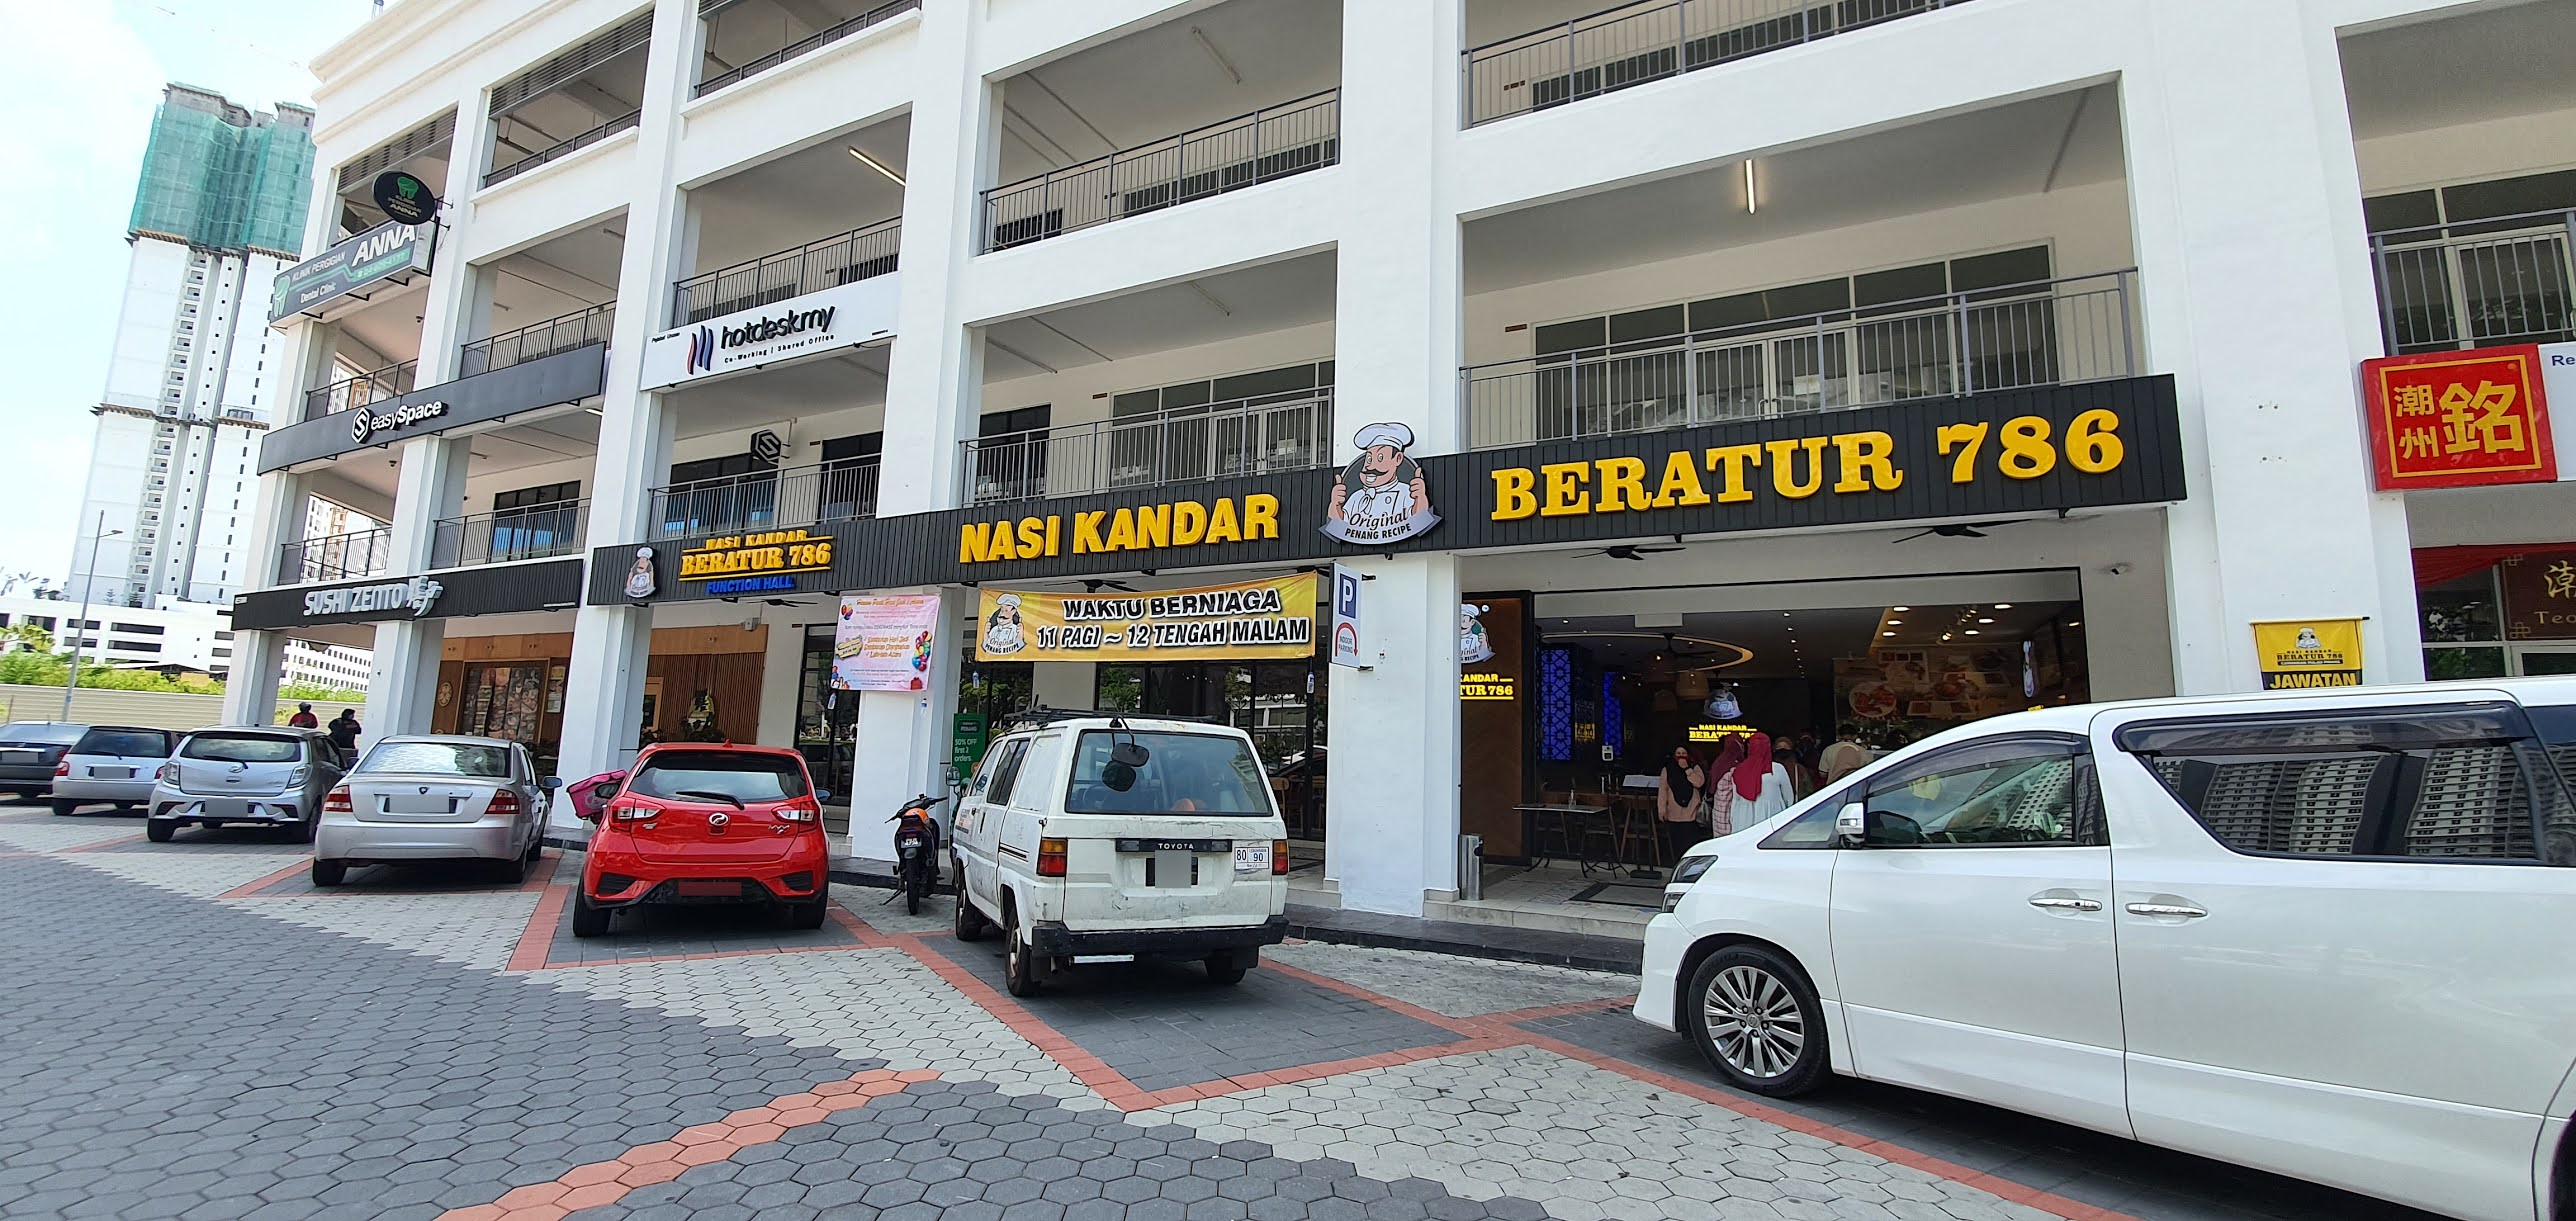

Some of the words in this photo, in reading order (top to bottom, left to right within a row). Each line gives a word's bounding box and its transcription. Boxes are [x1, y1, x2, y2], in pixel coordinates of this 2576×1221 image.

[390, 203, 418, 217] ANNA
[352, 224, 416, 267] ANNA
[291, 267, 311, 282] KLINIK
[311, 252, 346, 274] PERGIGIAN
[301, 290, 319, 304] Dental
[320, 282, 336, 296] Clinic
[724, 349, 768, 363] Co-Working
[777, 340, 805, 352] Shared
[808, 334, 835, 345] Office
[371, 401, 442, 430] easySpace
[2439, 380, 2525, 454] 銘
[1491, 430, 1904, 521] BERATUR
[1936, 408, 2125, 484] 786
[959, 514, 1061, 564] NASI
[1073, 493, 1280, 555] KANDAR
[1350, 508, 1409, 531] Original
[705, 536, 741, 551] NASI
[745, 530, 809, 547] KANDAR
[1345, 528, 1379, 540] PENANG
[1382, 523, 1412, 539] RECIPE
[680, 547, 785, 577] BERATUR
[789, 543, 833, 566] 786
[706, 578, 762, 595] FUNCTION
[763, 577, 795, 592] HALL
[1342, 578, 1354, 613] P
[303, 589, 349, 616] SUSHI
[350, 583, 408, 612] ZENTO
[1063, 598, 1145, 620] WAKTU
[1150, 589, 1282, 618] BERNIAGA
[989, 637, 1014, 645] Original
[1037, 625, 1058, 648] 11
[1061, 625, 1102, 648] PAGI
[1127, 624, 1149, 647] 12
[1153, 621, 1226, 646] TENGAH
[1230, 617, 1310, 645] MALAM
[985, 643, 1002, 653] PENANG
[1488, 685, 1514, 696] 786
[2270, 673, 2356, 689] JAWATAN
[954, 738, 966, 746] 50%
[1236, 849, 1247, 861] 80
[1253, 852, 1264, 862] 90
